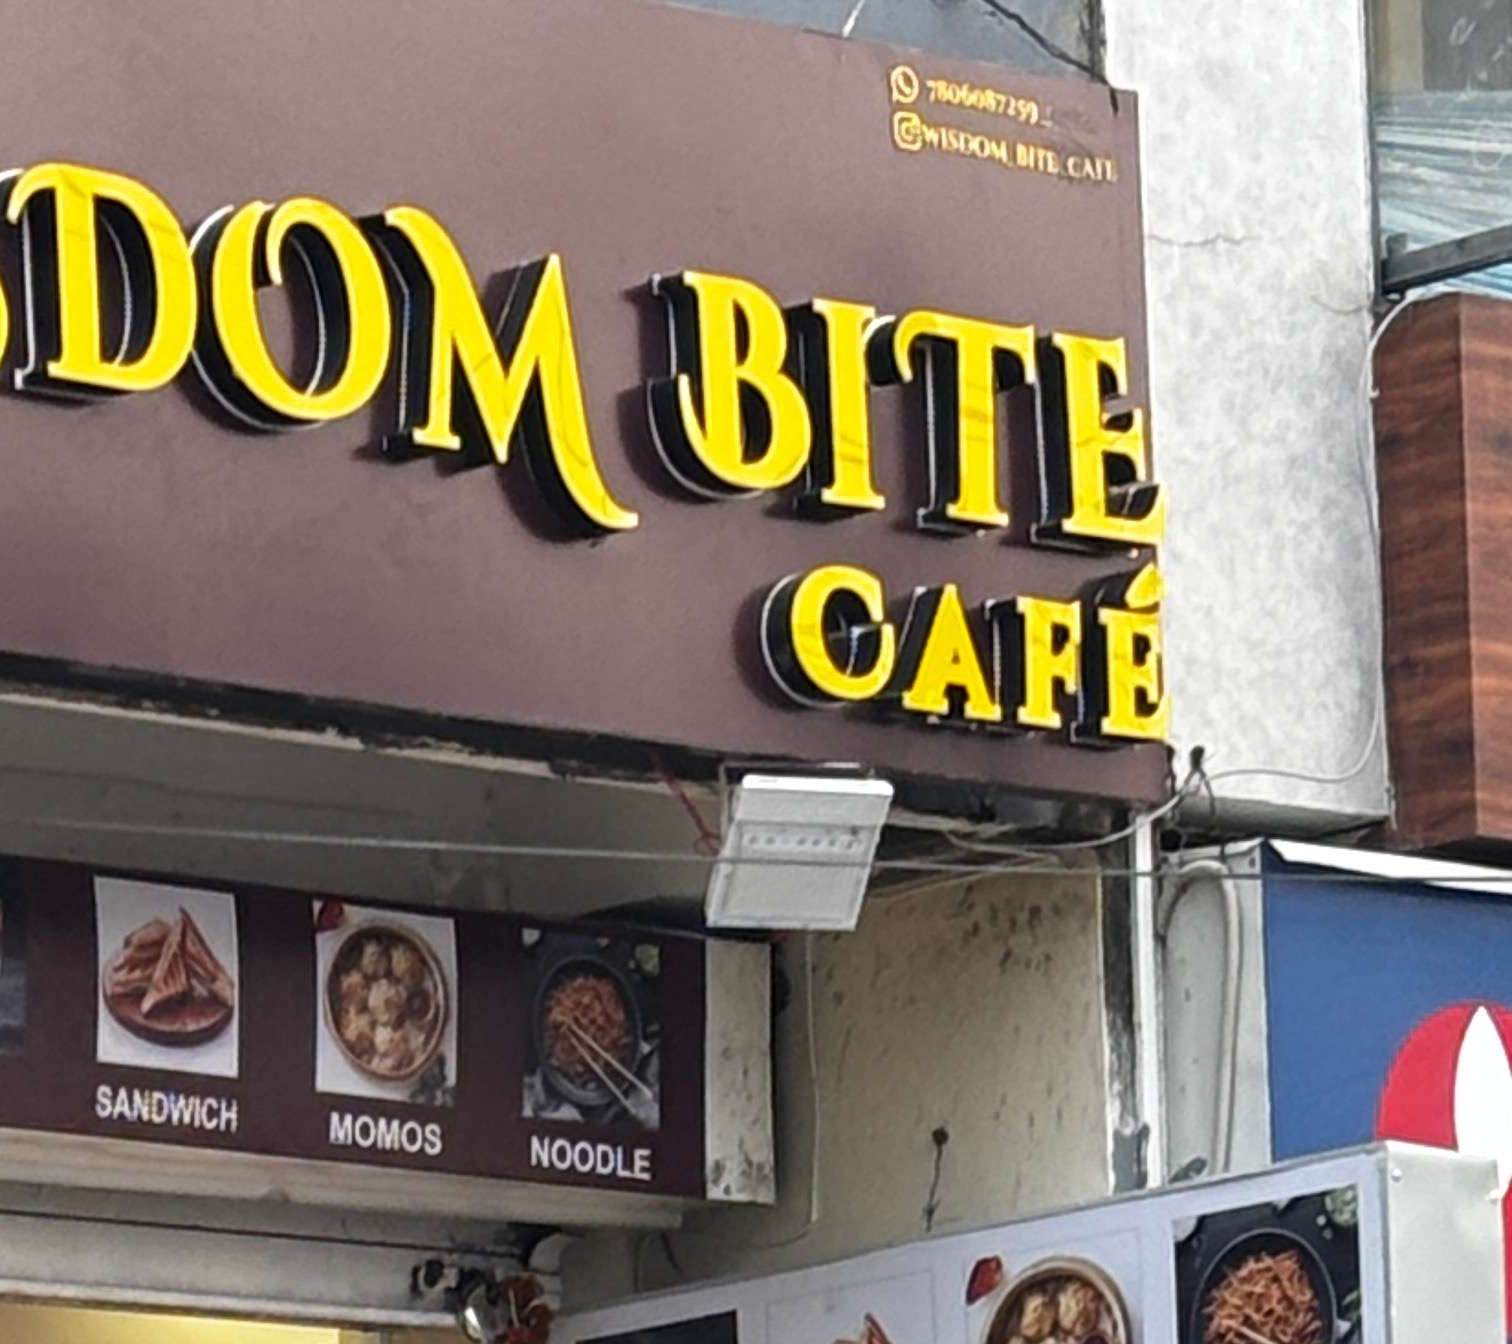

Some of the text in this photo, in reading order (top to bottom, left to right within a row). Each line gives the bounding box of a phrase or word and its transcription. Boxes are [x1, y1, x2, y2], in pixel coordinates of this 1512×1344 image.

[668, 268, 1168, 548] BITE
[784, 562, 1171, 742] CAFÉ
[94, 1083, 239, 1134] SANDWICH
[328, 1111, 443, 1156] MOMOS
[529, 1134, 653, 1181] NOODLE
